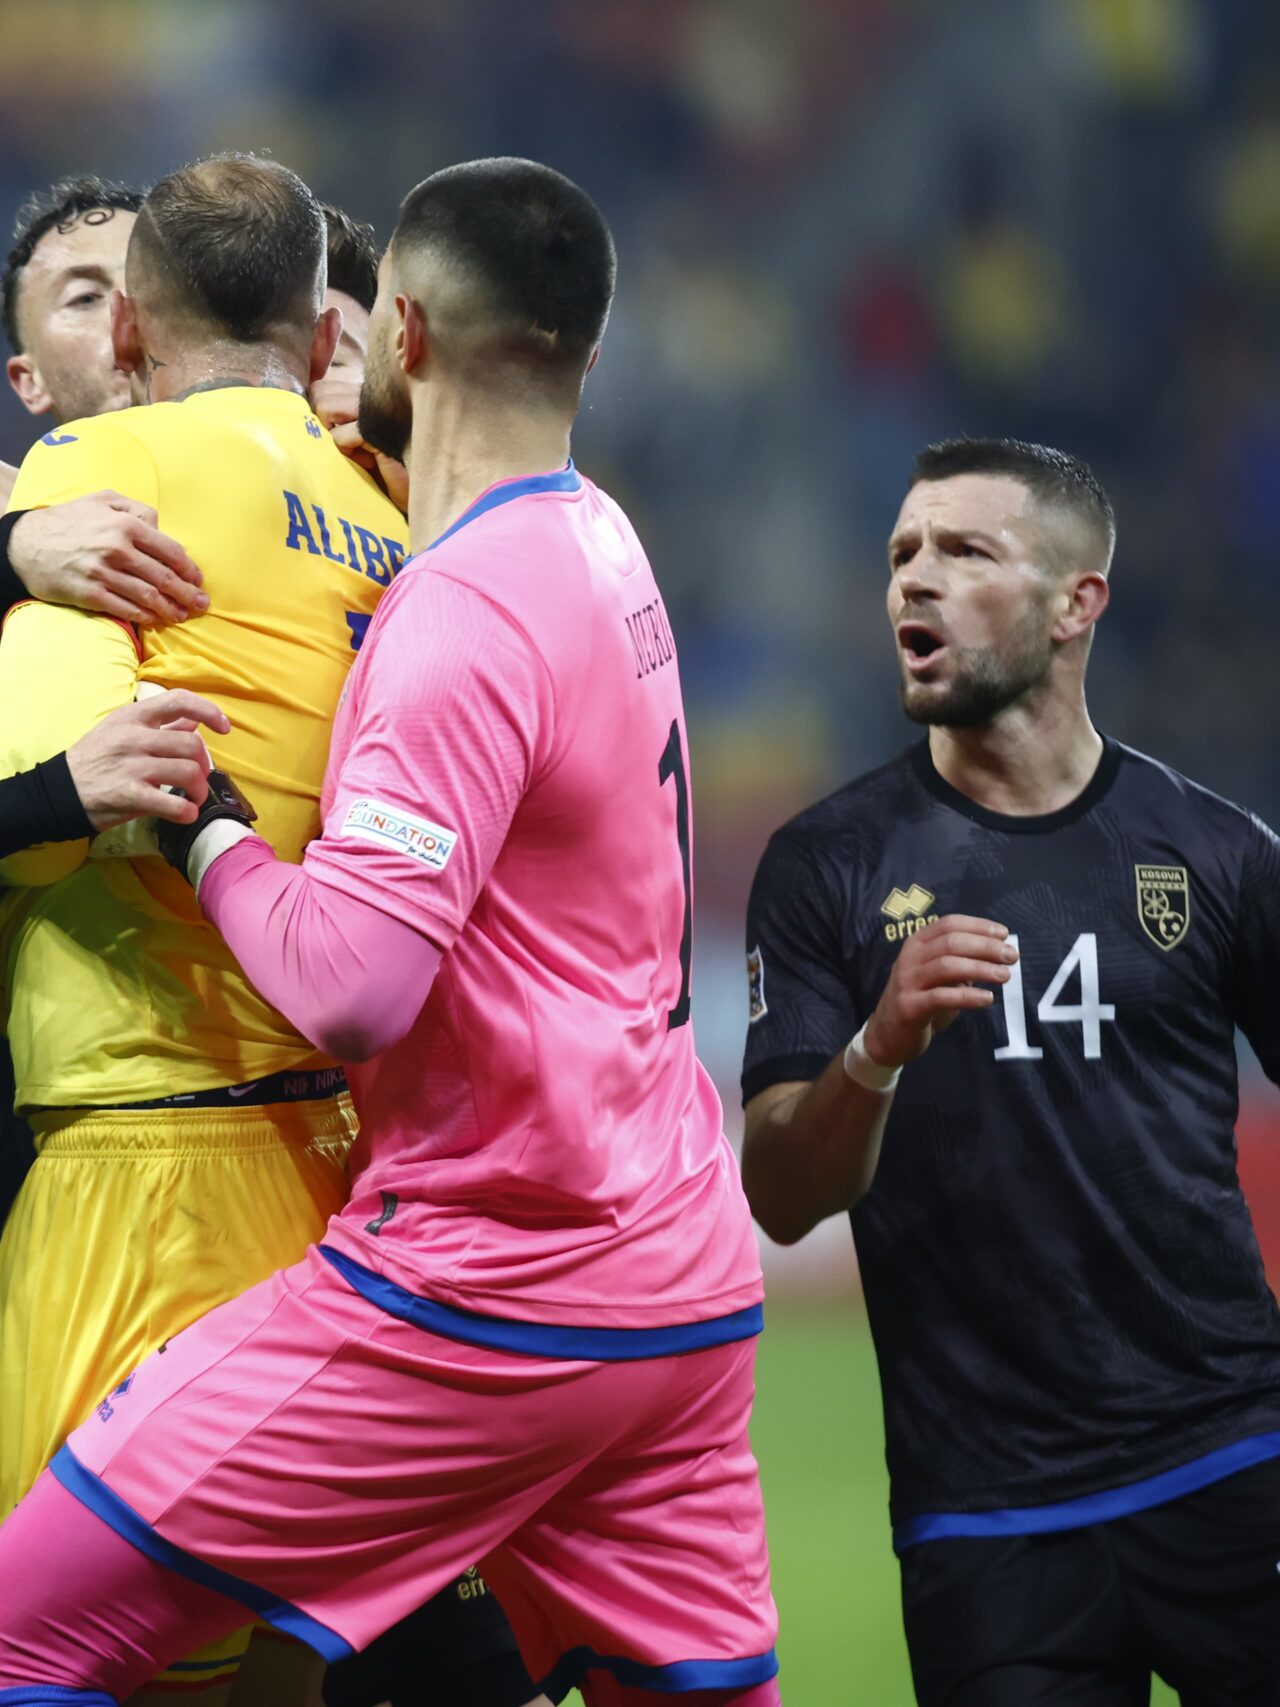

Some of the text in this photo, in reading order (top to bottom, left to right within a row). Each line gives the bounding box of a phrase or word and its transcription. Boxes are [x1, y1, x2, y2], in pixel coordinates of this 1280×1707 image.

[282, 489, 406, 588] ALIBE
[658, 717, 692, 1034] 1
[1140, 869, 1182, 881] KOSOVA
[993, 933, 1116, 1060] 14
